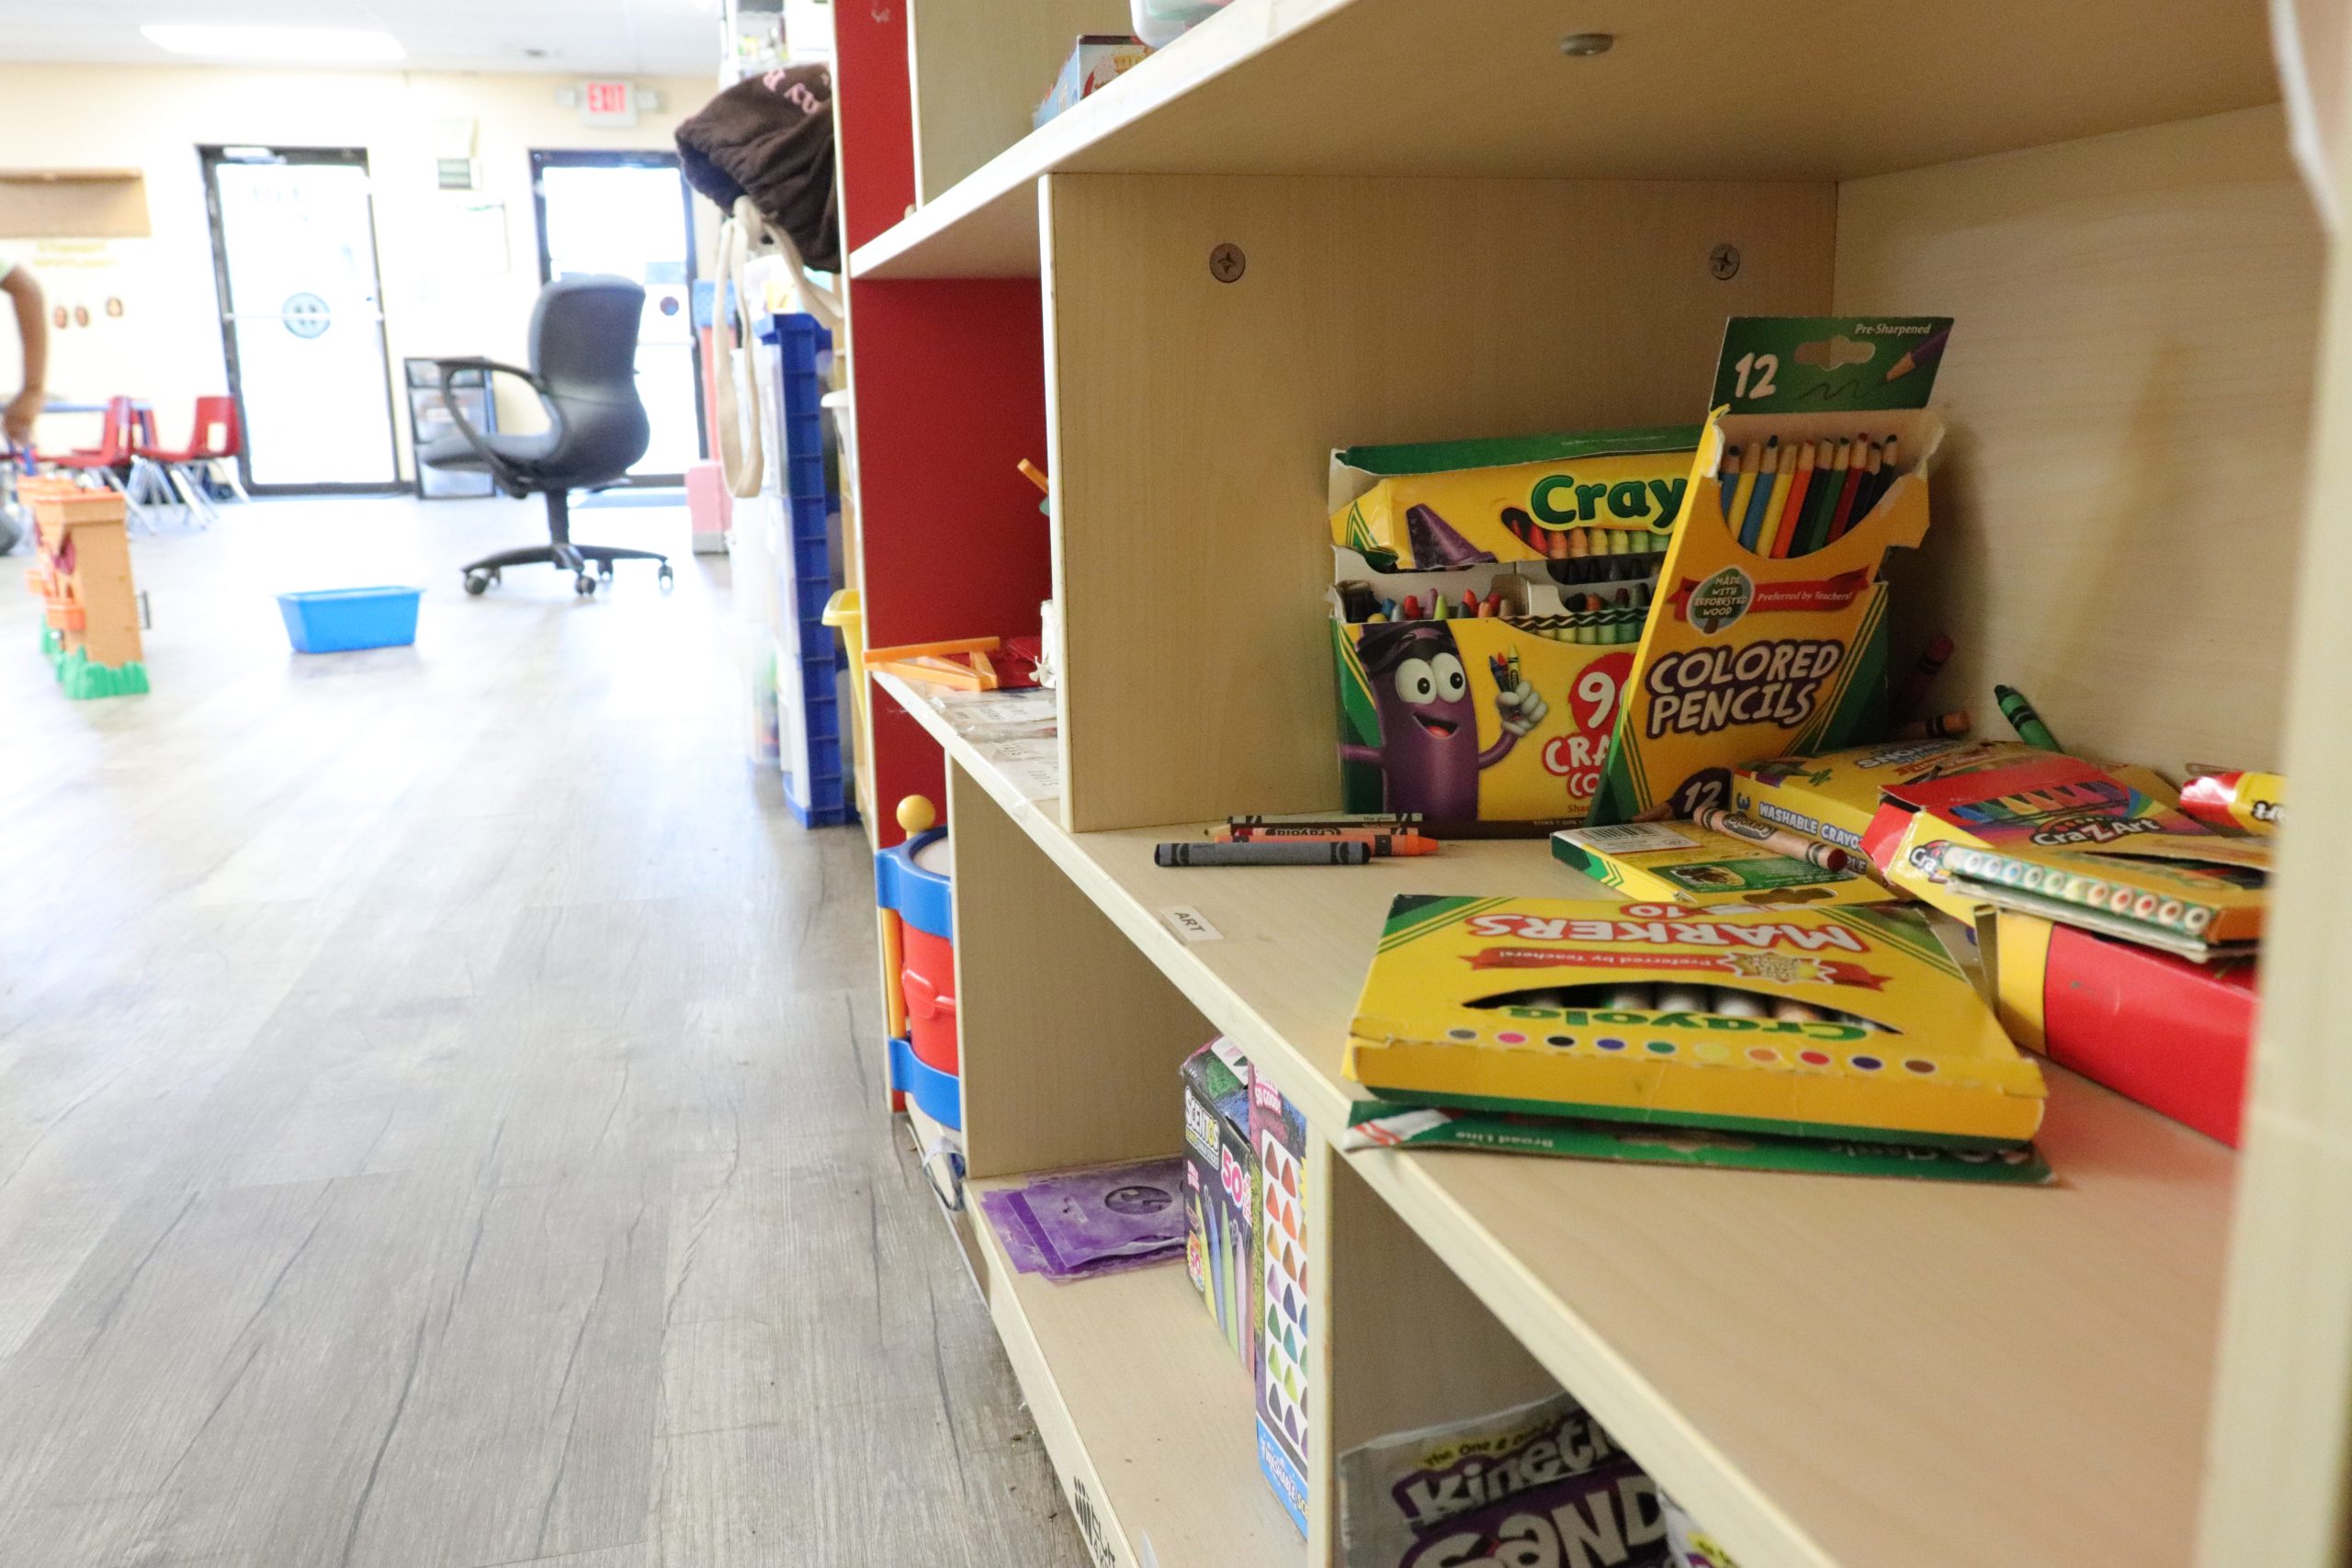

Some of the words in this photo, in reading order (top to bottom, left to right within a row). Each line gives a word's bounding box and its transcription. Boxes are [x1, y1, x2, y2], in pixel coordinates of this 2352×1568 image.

[588, 81, 626, 113] EXIT
[1854, 323, 1932, 335] Pre-Sharpened
[1736, 352, 1780, 400] 12
[1531, 474, 1689, 529] Cray
[1712, 587, 1737, 596] WITH
[1715, 576, 1741, 585] MADE
[1694, 596, 1747, 606] REFORESTED
[1758, 592, 1801, 602] Preferred
[1801, 592, 1813, 601] by
[1703, 606, 1733, 616] WOOD
[1650, 644, 1840, 694] COLORED
[1577, 671, 1630, 729] 9
[1651, 682, 1816, 735] PENCILS
[1683, 780, 1724, 813] 12
[1728, 814, 1772, 839] Crayola
[1759, 802, 1818, 836] WASHABLE
[1275, 828, 1338, 836] Crayola
[1174, 912, 1205, 932] ART
[1629, 905, 1689, 918] 10
[1472, 915, 1864, 953] MARKERS
[1591, 954, 1615, 964] by
[1620, 955, 1712, 965] Preferred
[1508, 1007, 1867, 1041] Crayola
[1185, 1088, 1220, 1152] SCENTOS
[1455, 1131, 1494, 1143] Line
[1498, 1134, 1555, 1148] Broad
[1222, 1146, 1242, 1206] 50
[1459, 1440, 1490, 1455] One
[1406, 1417, 1612, 1524] Kineti
